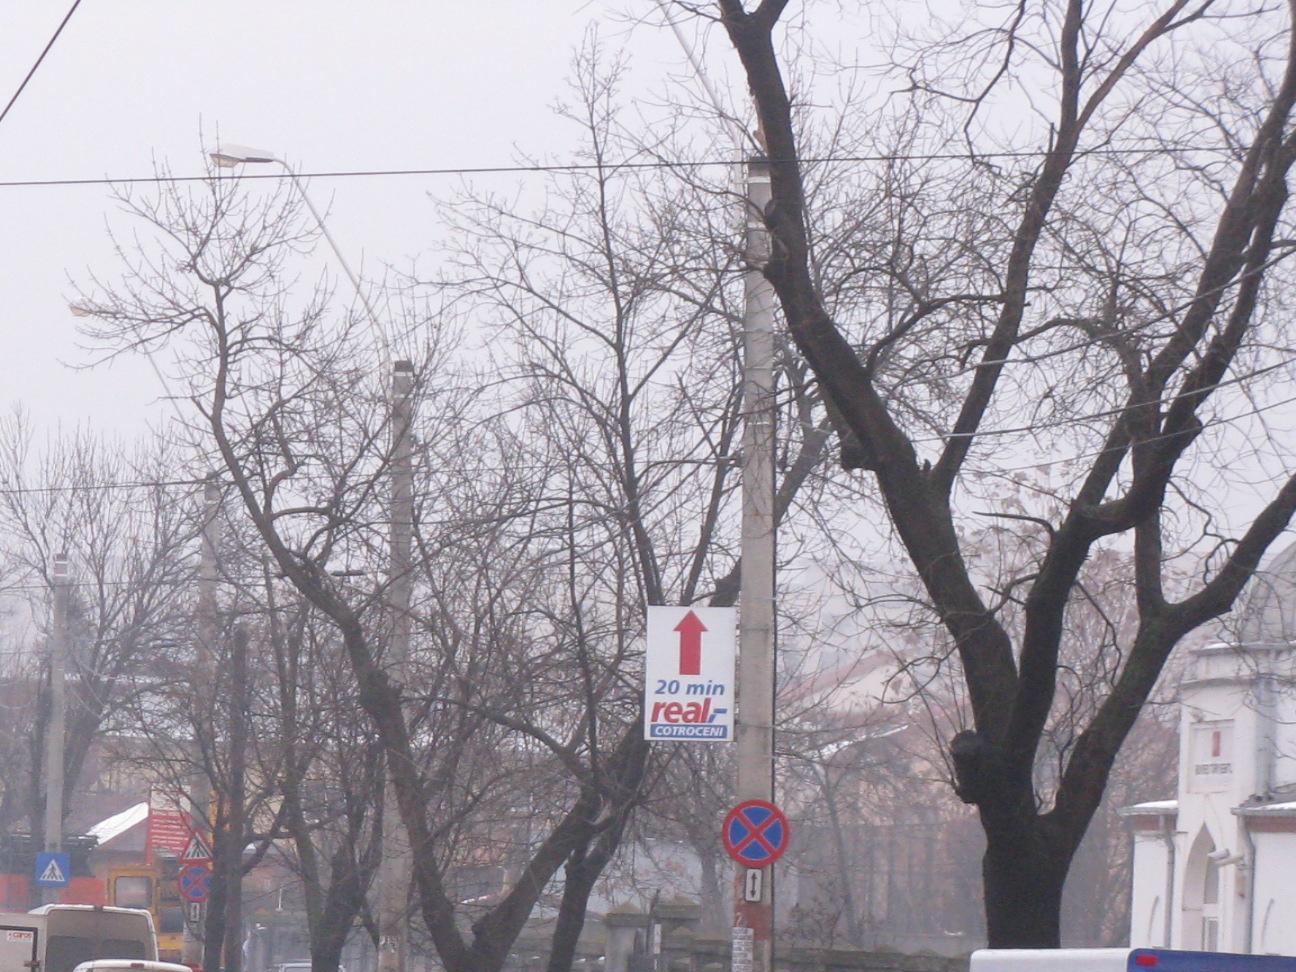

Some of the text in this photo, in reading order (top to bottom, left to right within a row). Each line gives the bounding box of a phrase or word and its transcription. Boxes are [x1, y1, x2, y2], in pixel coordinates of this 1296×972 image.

[655, 679, 725, 695] 20 min
[655, 726, 724, 737] COTROCENI
